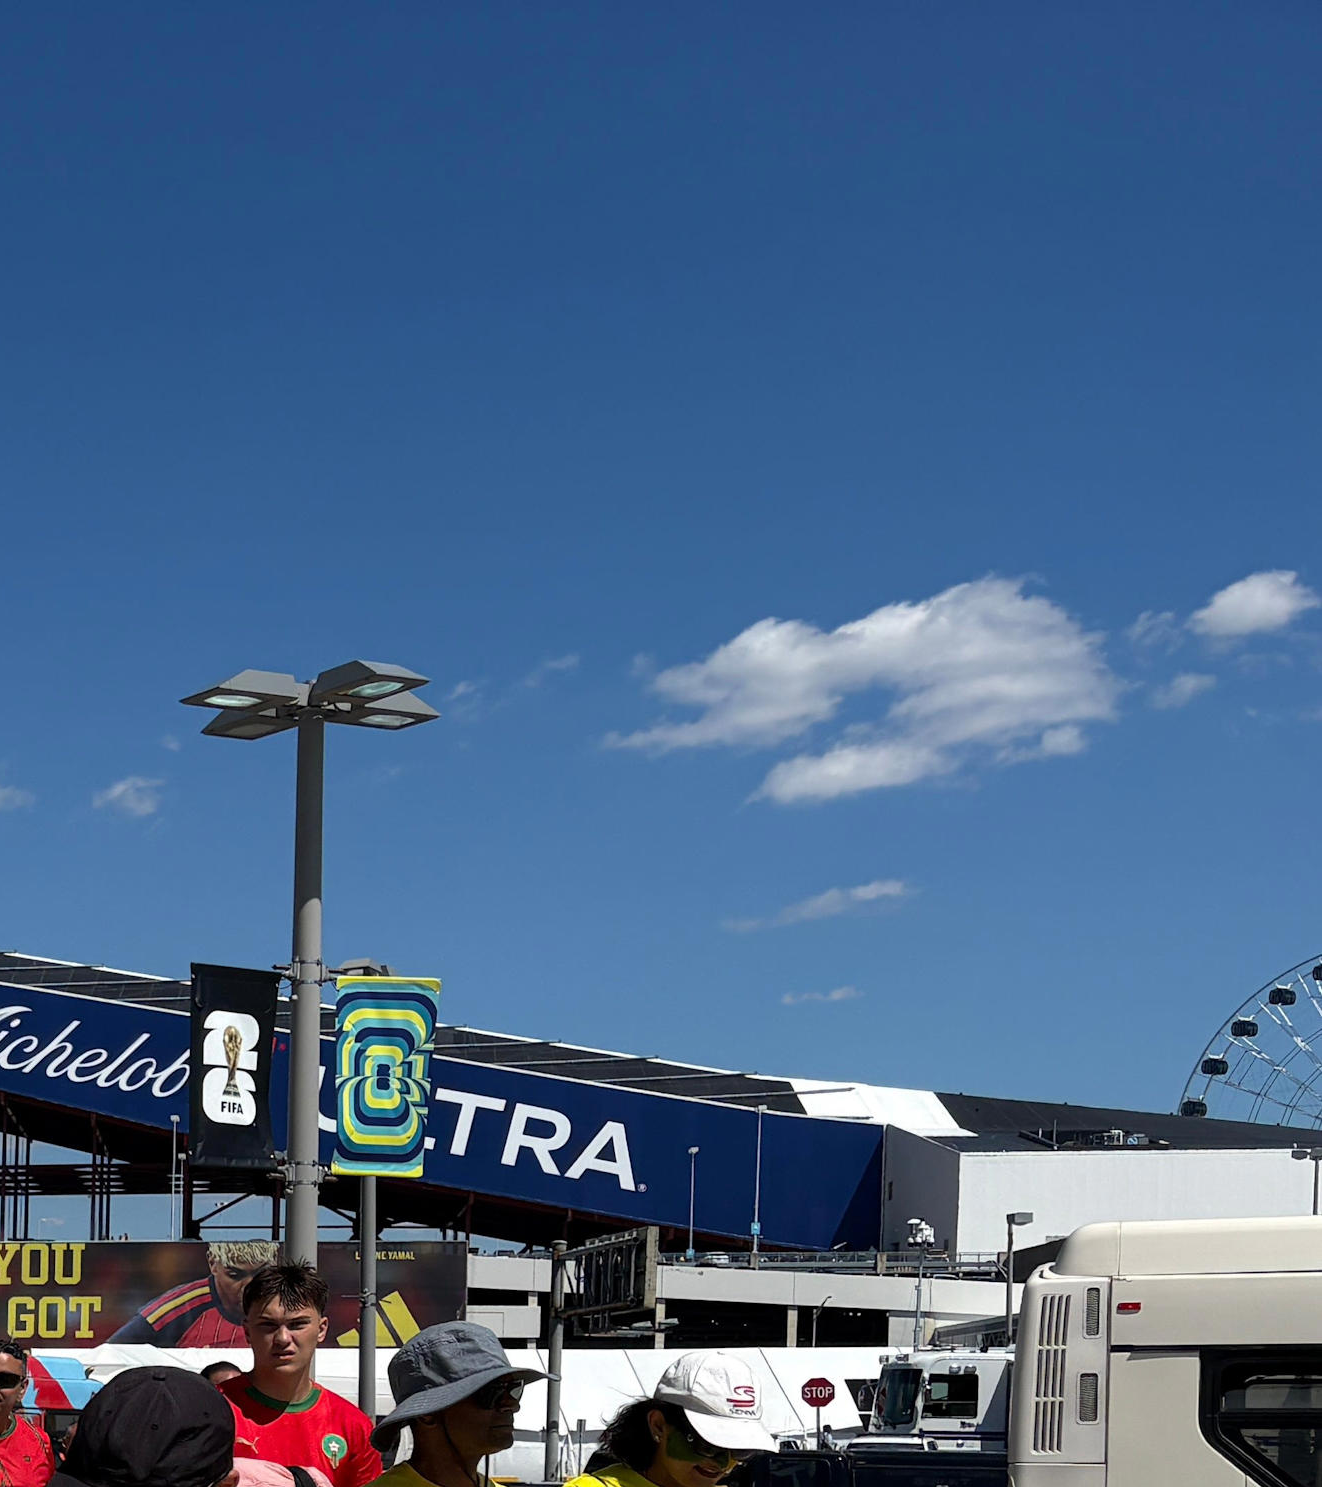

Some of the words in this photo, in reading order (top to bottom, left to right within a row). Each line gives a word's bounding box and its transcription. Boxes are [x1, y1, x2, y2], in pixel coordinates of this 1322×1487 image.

[220, 1101, 244, 1116] FIFA
[355, 1251, 387, 1260] LNE
[388, 1251, 415, 1260] YAMAL
[7, 1296, 102, 1339] GOT
[803, 1386, 833, 1399] STOP
